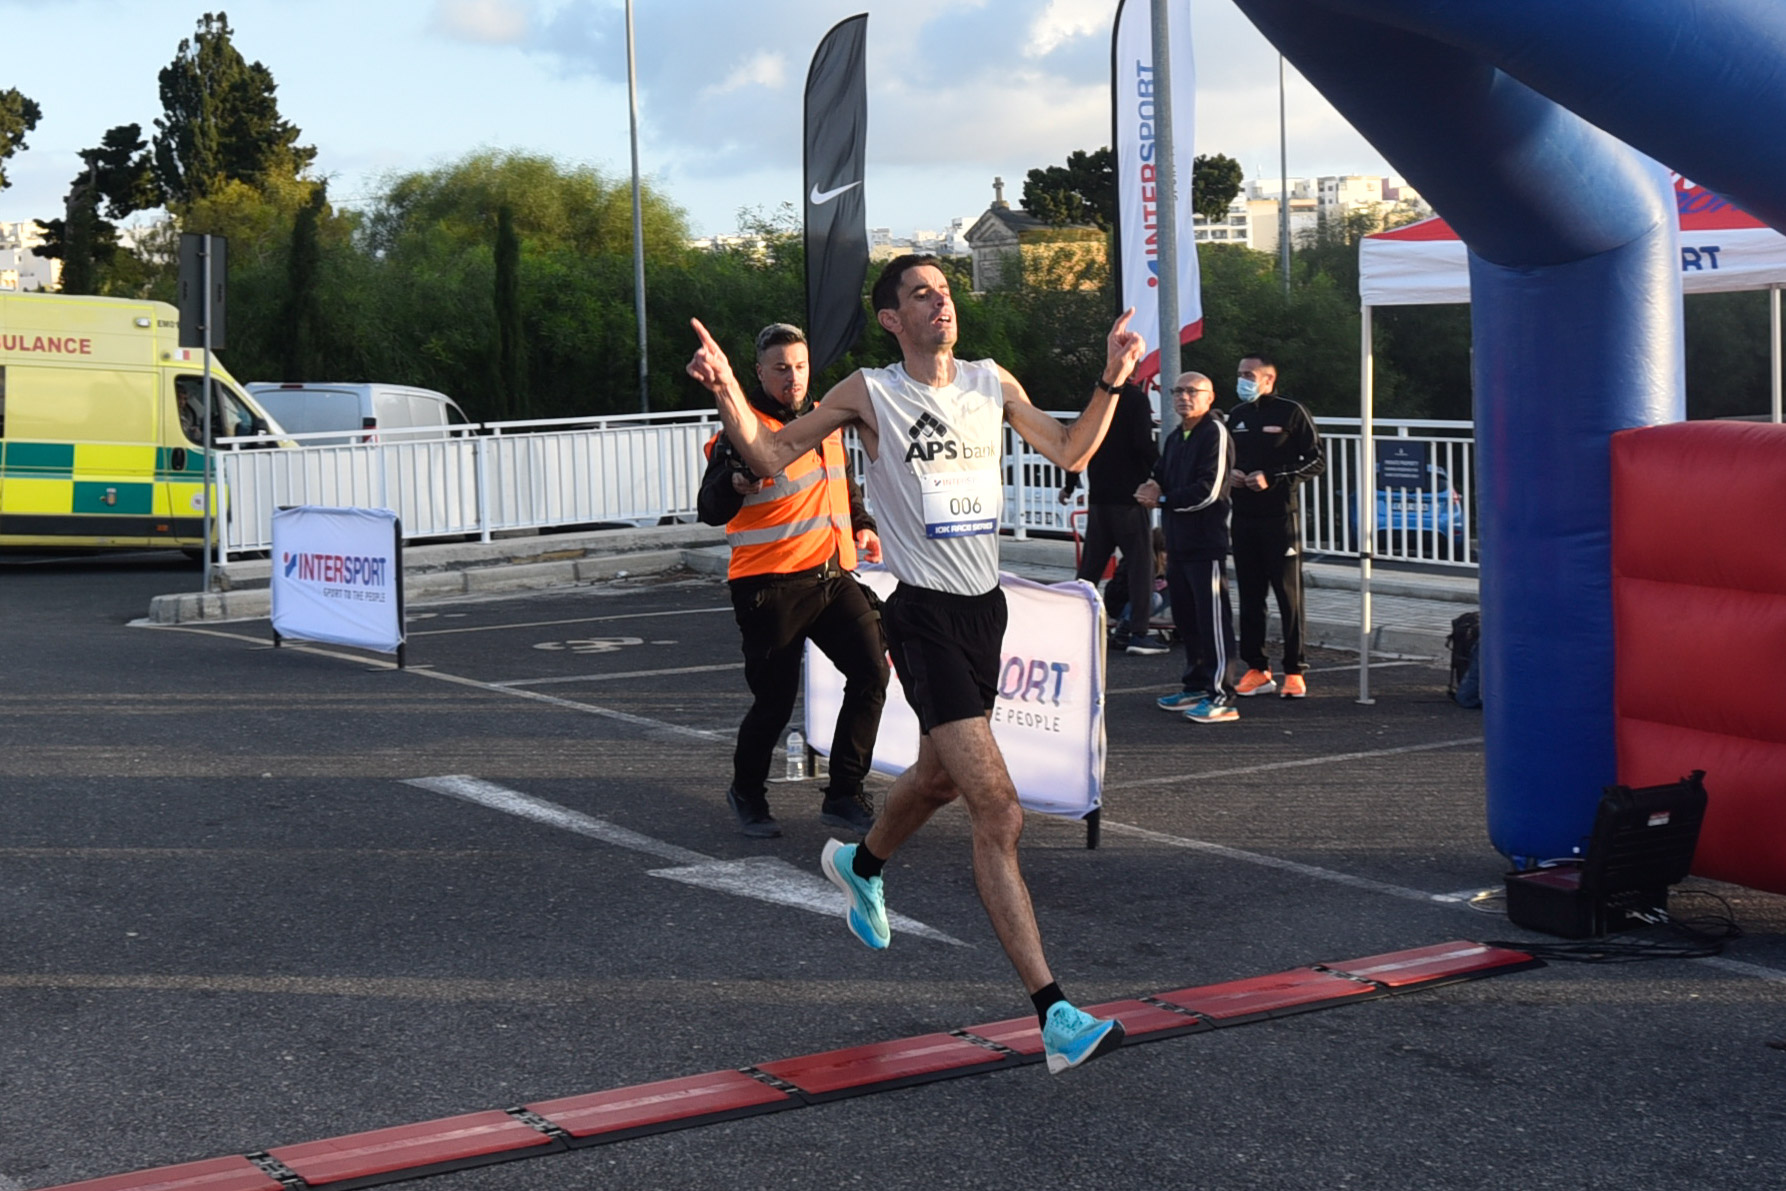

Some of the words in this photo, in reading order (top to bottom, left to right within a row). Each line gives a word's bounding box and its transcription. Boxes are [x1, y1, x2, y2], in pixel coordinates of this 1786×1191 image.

[0, 334, 92, 355] ULANCE
[905, 440, 958, 463] APS
[962, 441, 996, 459] bank
[949, 497, 982, 516] 006
[298, 553, 386, 586] INTERSPORT
[1007, 709, 1060, 732] PEOPLE
